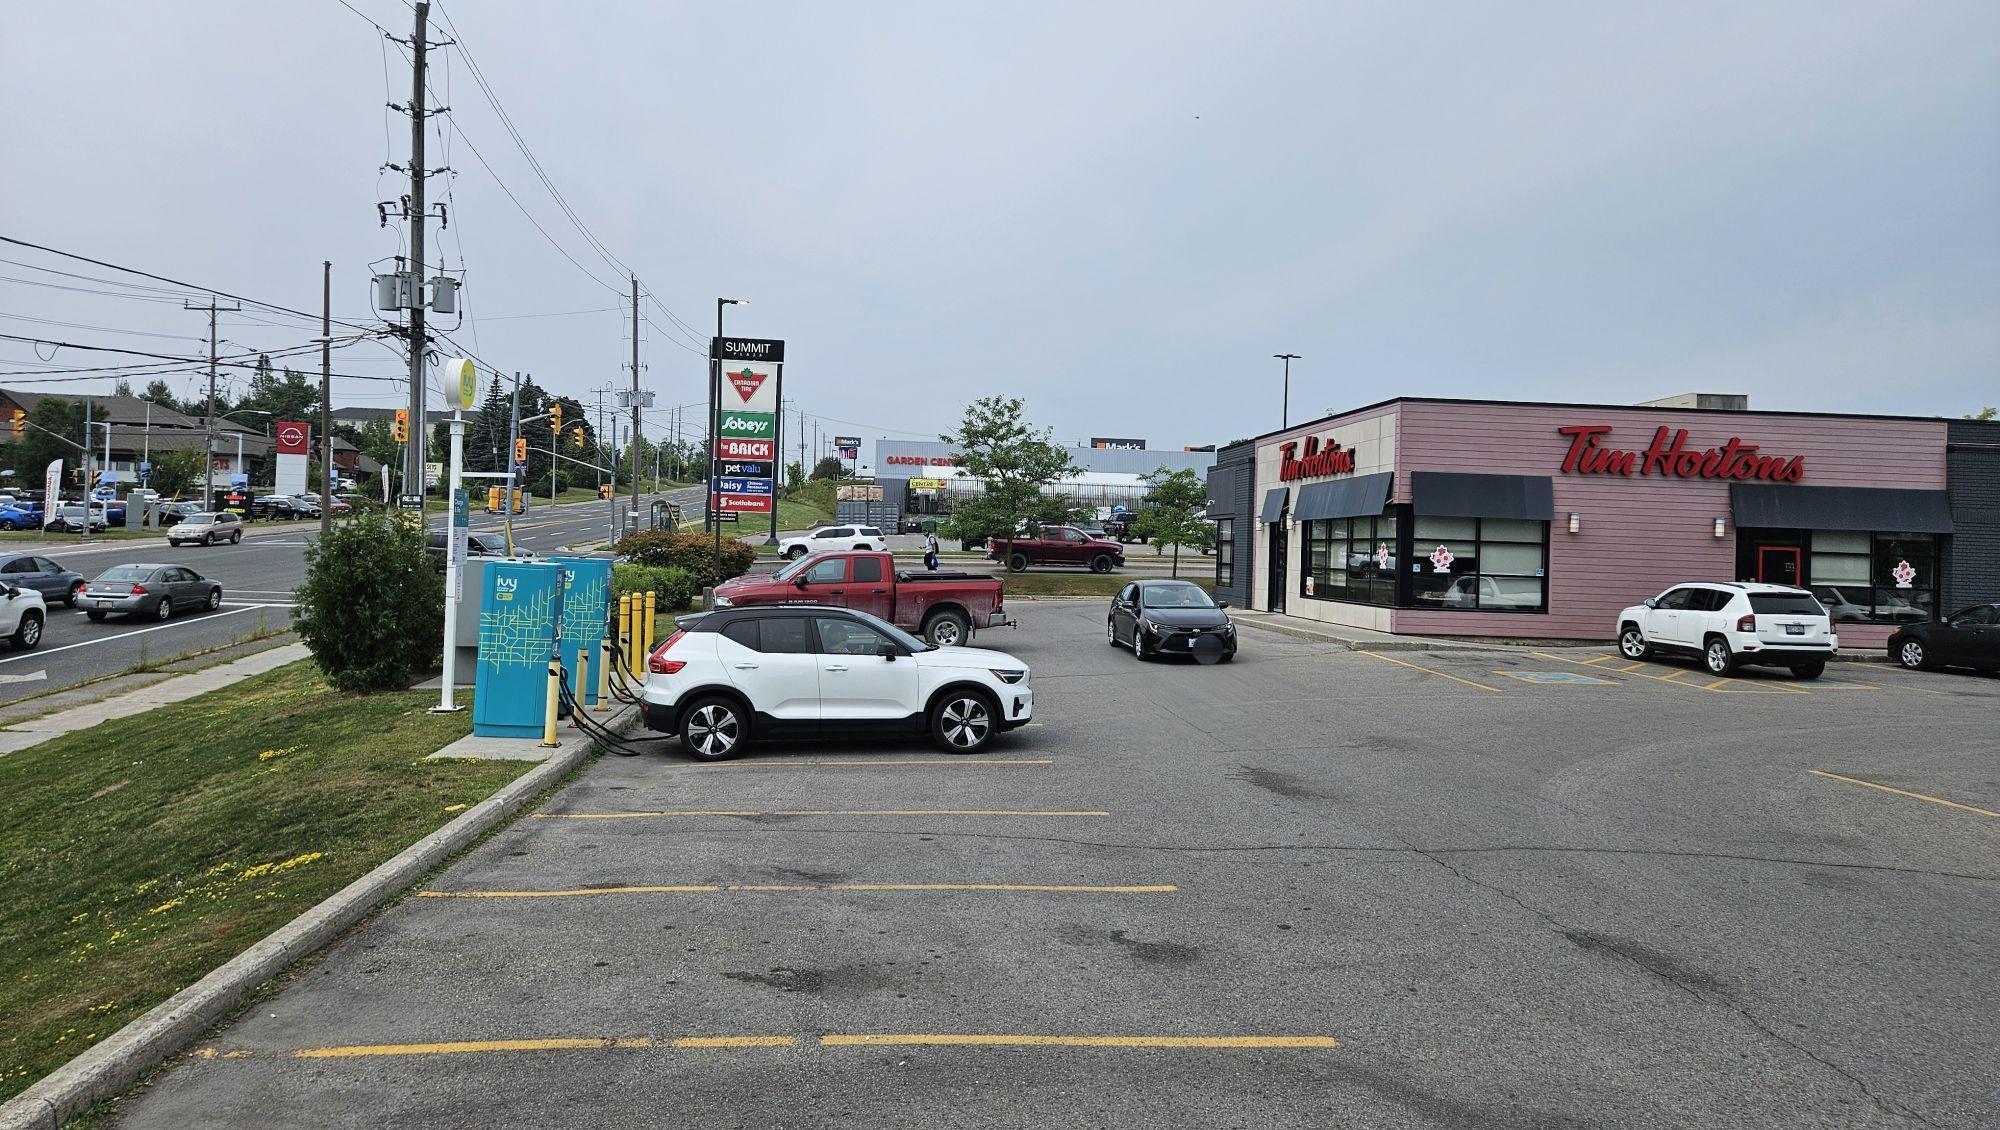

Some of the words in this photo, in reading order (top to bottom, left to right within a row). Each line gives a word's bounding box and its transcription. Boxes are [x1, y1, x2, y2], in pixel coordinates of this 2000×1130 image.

[725, 341, 771, 354] SUMMIT
[722, 416, 768, 434] Sobeys
[729, 442, 769, 456] BRICK
[1105, 442, 1141, 450] Mark's
[1558, 425, 1637, 477] Tim
[1640, 425, 1806, 482] Hortons
[886, 456, 928, 466] GARDEN
[1280, 441, 1301, 482] Tim
[1301, 435, 1355, 480] Hortons
[497, 574, 518, 592] ivy
